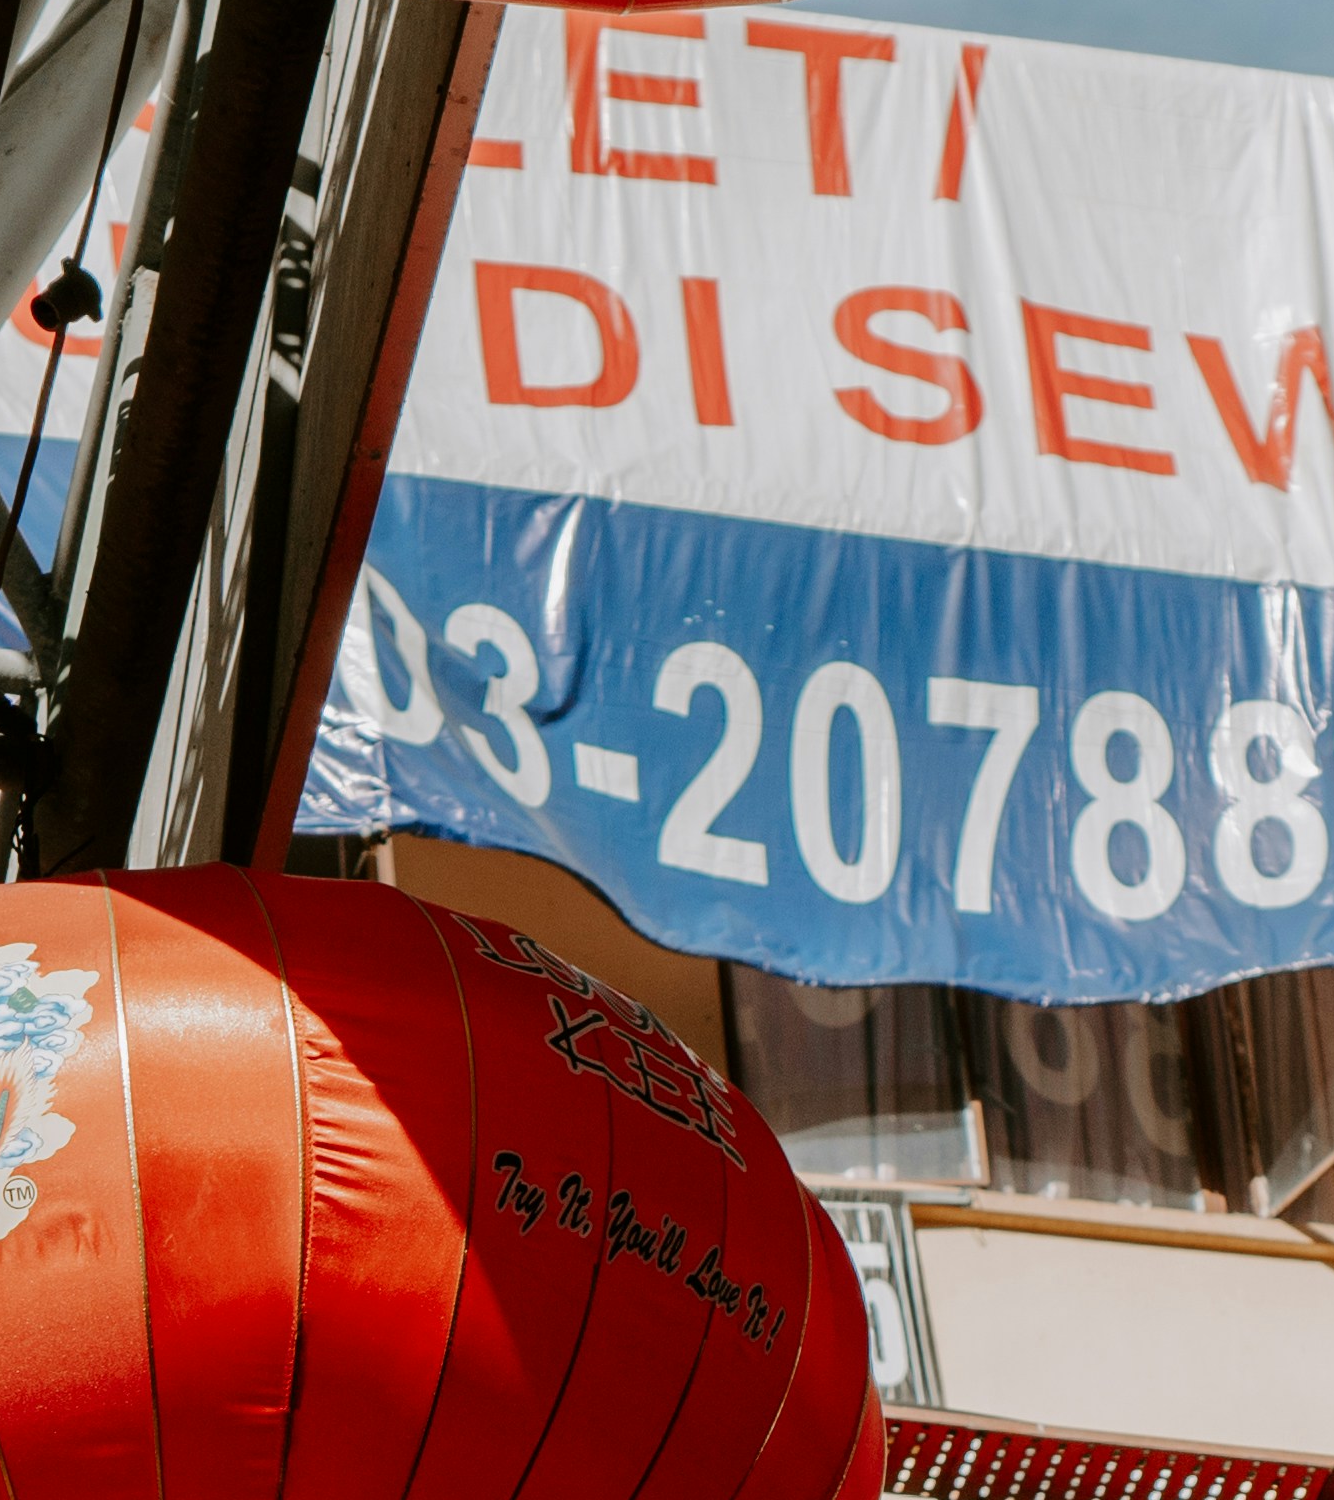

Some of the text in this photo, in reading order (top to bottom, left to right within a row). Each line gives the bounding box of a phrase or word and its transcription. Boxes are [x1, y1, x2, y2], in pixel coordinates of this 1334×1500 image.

[472, 259, 736, 429] DI
[5, 1185, 35, 1204] TM
[492, 1150, 548, 1235] Try
[605, 1190, 688, 1278] You'll
[684, 1245, 742, 1319] Love
